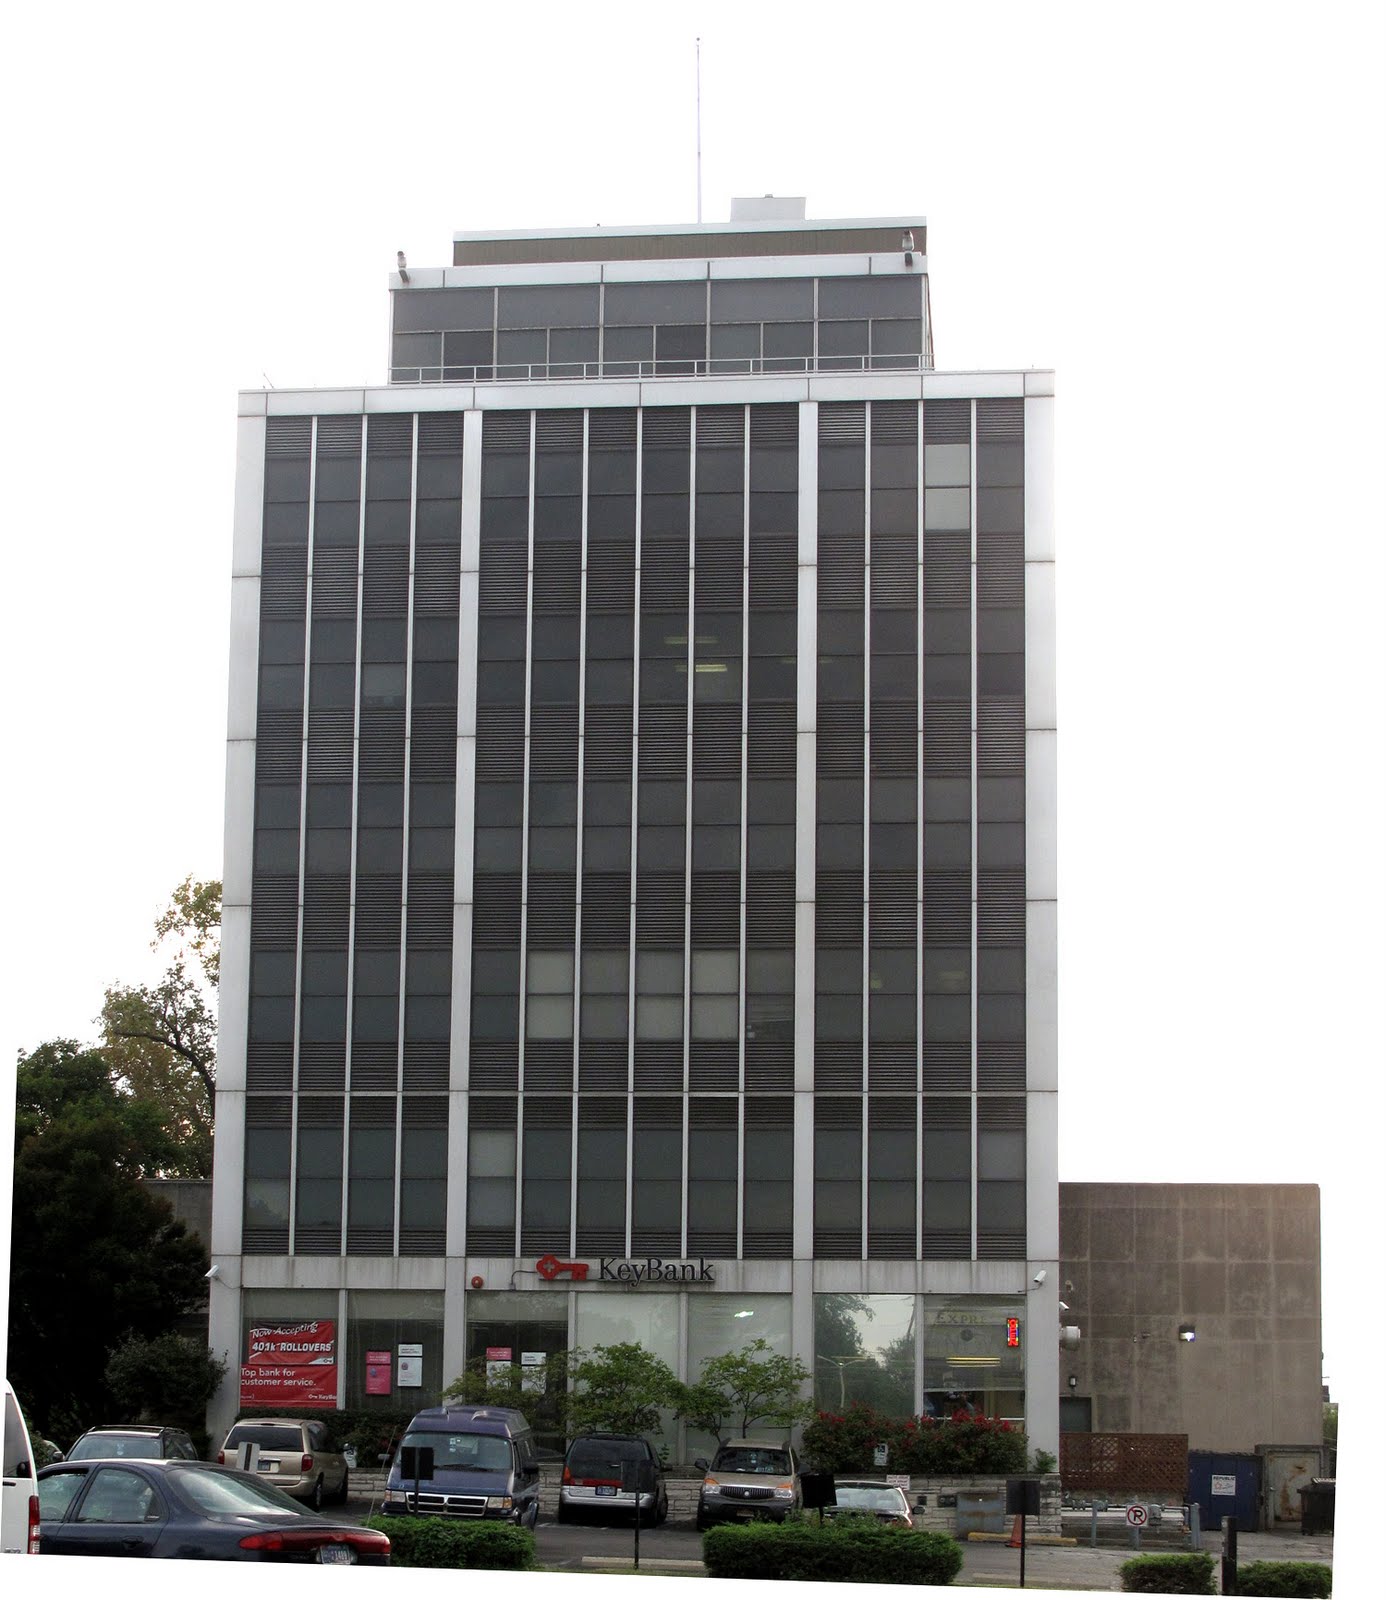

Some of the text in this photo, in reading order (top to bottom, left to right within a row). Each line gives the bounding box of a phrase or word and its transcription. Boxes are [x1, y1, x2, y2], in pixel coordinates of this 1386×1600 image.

[599, 1257, 715, 1287] KeyBank
[252, 1321, 318, 1339] Now Accepting
[1007, 1318, 1019, 1347] OPEN
[252, 1342, 332, 1352] 401k ROLLOVERS
[241, 1368, 296, 1378] Top bank for
[283, 1378, 317, 1386] service.
